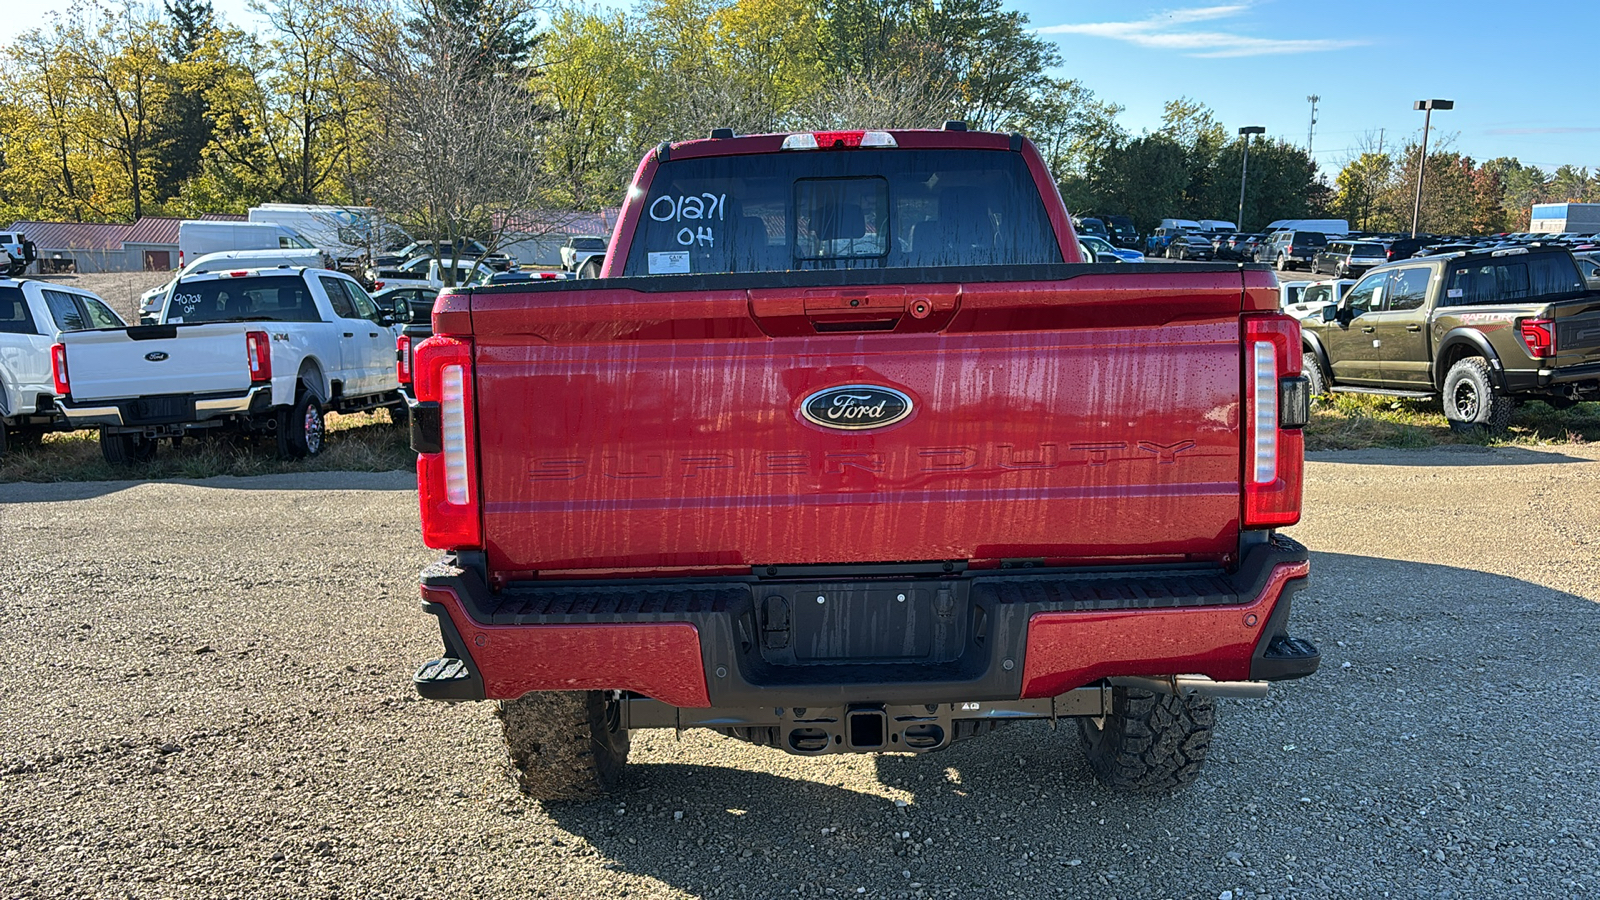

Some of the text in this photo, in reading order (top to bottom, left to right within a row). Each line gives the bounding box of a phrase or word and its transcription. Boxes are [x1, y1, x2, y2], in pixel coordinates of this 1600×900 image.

[649, 192, 726, 222] 01271
[676, 226, 714, 248] OH
[174, 293, 202, 305] 90708
[1459, 313, 1514, 325] RAPTOR
[148, 352, 165, 360] Ford
[827, 394, 887, 419] Ford
[527, 439, 1197, 481] SUPER DUTY
